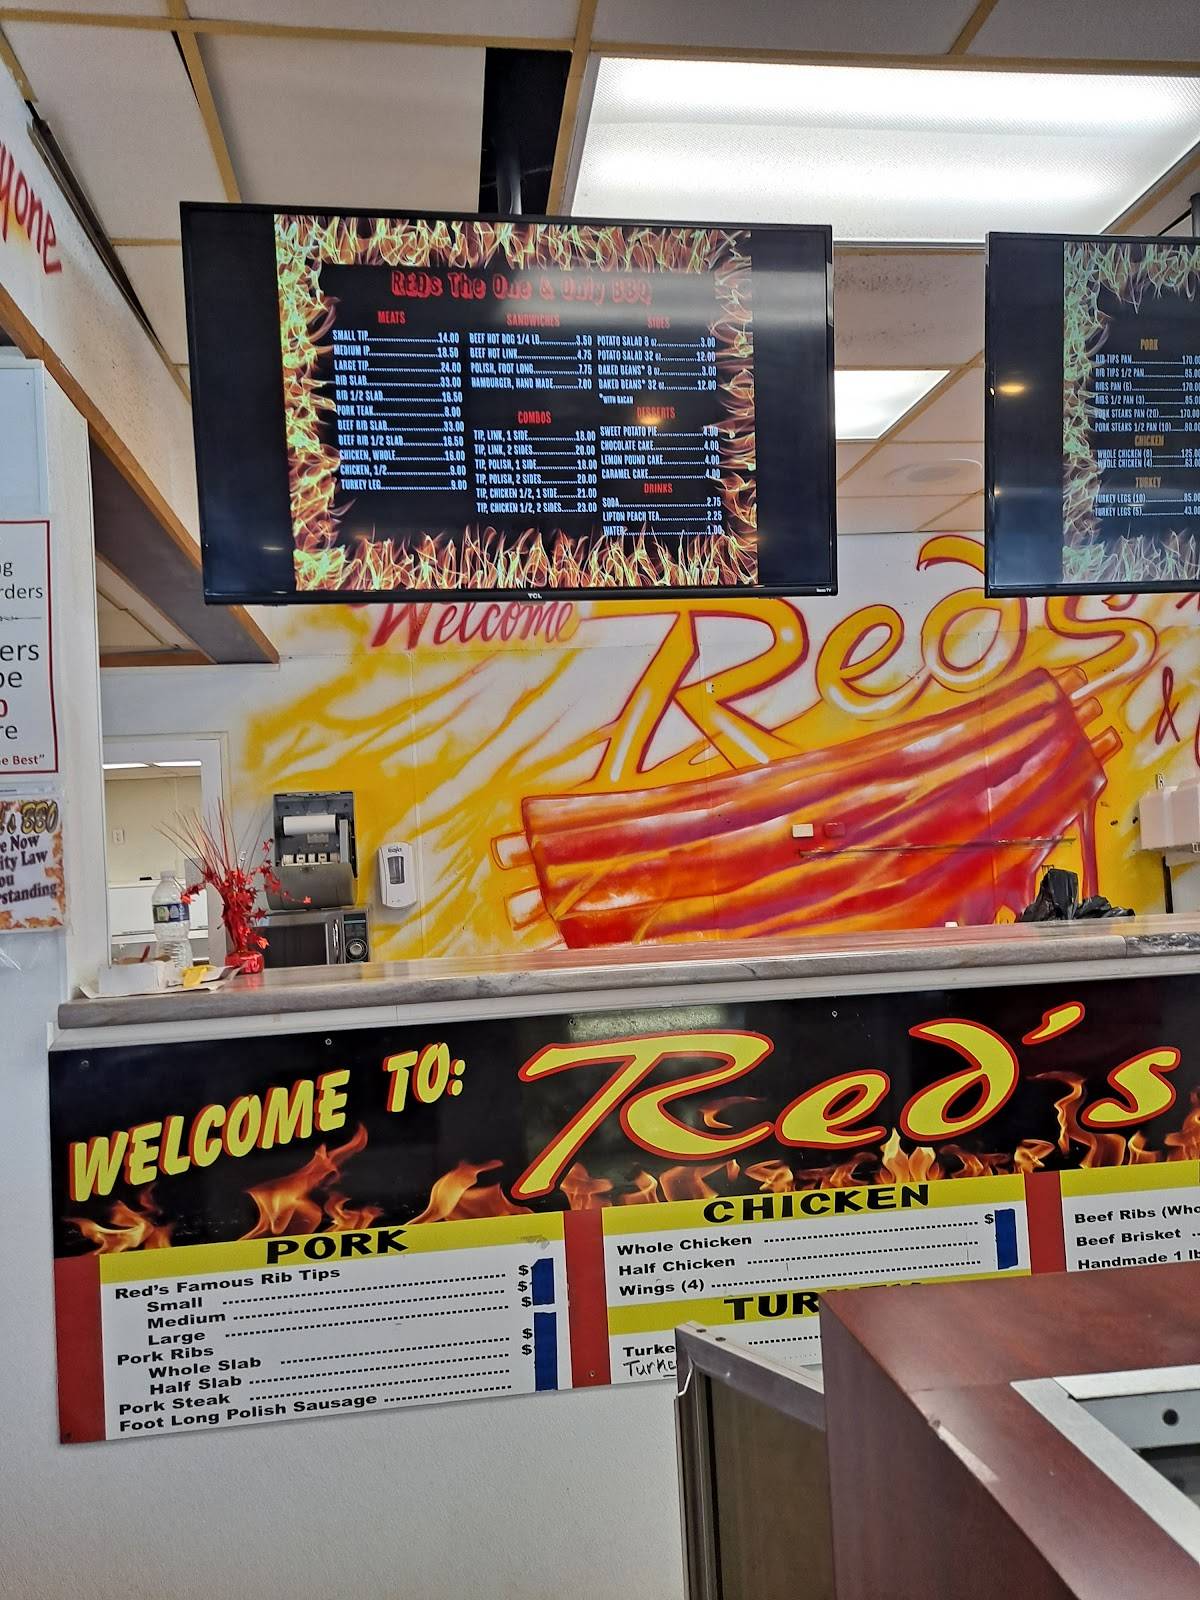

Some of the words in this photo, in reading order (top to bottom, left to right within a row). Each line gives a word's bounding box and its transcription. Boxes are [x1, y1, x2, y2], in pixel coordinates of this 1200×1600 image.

[447, 272, 486, 300] The
[377, 310, 406, 324] MEATS
[506, 313, 560, 327] SANDWICHES
[647, 316, 671, 329] SIDES
[332, 330, 355, 340] SMALL
[357, 330, 368, 340] TIP
[438, 332, 459, 343] 14.00
[469, 332, 485, 344] BEEF
[487, 333, 500, 344] HOT
[501, 333, 515, 344] DOG
[516, 334, 530, 345] 1/4
[575, 335, 592, 346] 3.50
[597, 335, 620, 346] POTATO
[622, 335, 642, 347] SALAD
[644, 336, 650, 347] 8
[700, 337, 716, 348] 3.00
[1140, 338, 1158, 350] PORK
[469, 347, 486, 358] BEEF
[487, 348, 500, 359] HOT
[501, 348, 518, 359] LINK
[577, 349, 592, 360] 4.75
[1107, 354, 1119, 363] TIPS
[1120, 354, 1132, 363] PAN
[334, 360, 356, 371] LARGE
[357, 360, 369, 371] TIP
[440, 362, 462, 373] 24.00
[1106, 368, 1119, 378] TIPS
[1120, 368, 1132, 378] 1/2
[1133, 368, 1145, 377] PAN
[517, 410, 552, 424] COMBOS
[1095, 422, 1110, 432] PORK
[1111, 422, 1133, 432] STEAKS
[1134, 422, 1145, 432] 1/2
[1146, 422, 1158, 432] PAN
[1158, 422, 1172, 432] (10)
[506, 430, 512, 440] 1
[513, 430, 529, 441] SIDE
[1134, 434, 1164, 447] CHICKEN
[600, 440, 637, 451] CHOCOLATE
[637, 440, 654, 451] CAKE
[704, 440, 719, 451] 4.00
[372, 450, 396, 461] WHOLE
[600, 454, 623, 465] LEMON
[624, 454, 646, 465] POUND
[647, 454, 664, 465] CAKE
[704, 454, 720, 465] 4.00
[1097, 449, 1117, 459] WHOLE
[1117, 449, 1142, 459] CHICKEN
[1143, 449, 1153, 459] (8)
[373, 464, 388, 475] 1/2
[450, 464, 467, 476] 9.00
[341, 479, 368, 490] TURKEY
[368, 479, 381, 490] LEG
[451, 479, 467, 490] 9.00
[643, 483, 673, 494] DRINKS
[1135, 476, 1161, 488] TURKEY
[602, 497, 619, 508] SODA
[706, 496, 722, 507] 2.75
[1095, 493, 1116, 503] TURKEY
[1117, 493, 1132, 503] LEGS
[1133, 493, 1146, 503] (10)
[490, 502, 519, 513] CHICKEN
[536, 502, 542, 513] 2
[543, 502, 562, 513] SIDES
[577, 502, 597, 513] 23.00
[1094, 507, 1116, 517] TURKEY
[1117, 507, 1131, 517] LEGS
[1133, 507, 1143, 517] (5)
[602, 511, 625, 522] LIPTON
[626, 511, 647, 522] PEACH
[648, 511, 660, 522] TEA
[707, 511, 722, 521] 2.25
[603, 525, 624, 536] WATER
[707, 525, 722, 535] 1.00
[371, 601, 576, 650] Welcome
[10, 835, 40, 852] Now
[21, 851, 48, 867] Law
[512, 1000, 1181, 1199] Red's
[68, 1069, 351, 1203] WELCOME
[383, 1041, 466, 1113] TO:
[703, 1184, 929, 1223] CHICKEN
[1074, 1210, 1113, 1224] Beef
[1119, 1208, 1156, 1220] Ribs
[617, 1242, 674, 1256] Whole
[679, 1235, 752, 1251] Chicken
[984, 1213, 994, 1225] $
[1076, 1233, 1115, 1247] Beef
[1121, 1228, 1181, 1243] Brisket
[266, 1229, 408, 1264] PORK
[618, 1263, 656, 1276] Half
[662, 1257, 736, 1272] Chicken
[1078, 1252, 1168, 1270] Handmade
[1174, 1250, 1181, 1261] 1
[114, 1284, 169, 1300] Red's
[176, 1276, 254, 1293] Famous
[261, 1272, 293, 1285] Rib
[298, 1268, 341, 1282] Tips
[146, 1297, 203, 1313] Small
[518, 1264, 529, 1276] $
[619, 1283, 675, 1296] Wings
[681, 1278, 705, 1293] (4)
[147, 1312, 226, 1329] Medium
[517, 1280, 528, 1292] $
[148, 1330, 206, 1346] Large
[521, 1296, 532, 1308] $
[117, 1351, 164, 1366] Pork
[170, 1345, 214, 1360] Ribs
[148, 1363, 211, 1379] Whole
[218, 1357, 262, 1371] Slab
[522, 1327, 533, 1340] $
[623, 1344, 676, 1357] Turke
[150, 1380, 192, 1395] Half
[198, 1376, 242, 1390] Slab
[521, 1343, 533, 1356] $
[622, 1358, 676, 1377] Turke
[119, 1401, 166, 1415] Pork
[172, 1393, 231, 1409] Steak
[119, 1417, 164, 1432] Foot
[171, 1412, 220, 1427] Long
[227, 1404, 287, 1420] Polish
[293, 1395, 377, 1412] Sausage
